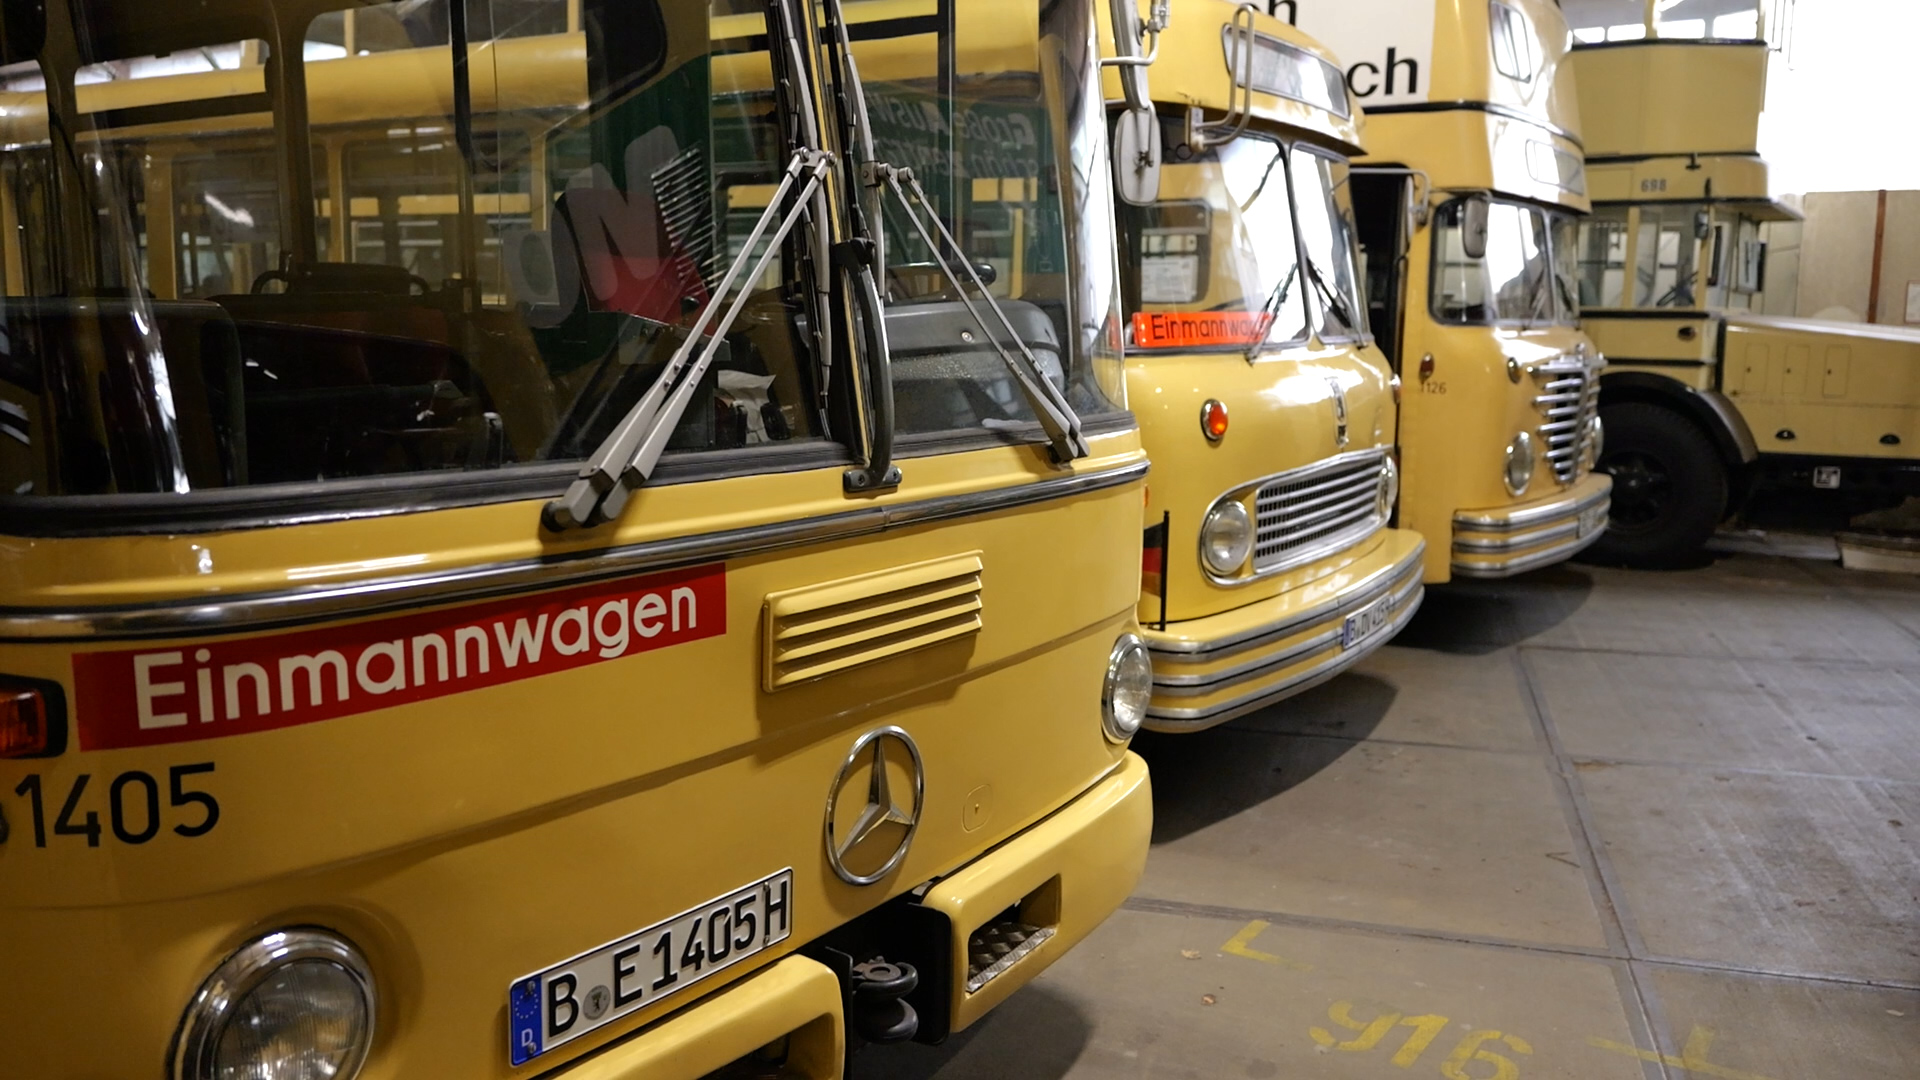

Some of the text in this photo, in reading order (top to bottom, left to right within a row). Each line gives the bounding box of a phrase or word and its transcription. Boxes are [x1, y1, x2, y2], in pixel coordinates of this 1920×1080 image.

[1641, 178, 1667, 192] 698
[133, 582, 697, 731] Einmannwagen
[14, 761, 220, 849] 1405
[549, 973, 578, 1037] B
[1309, 999, 1535, 1080] 916
